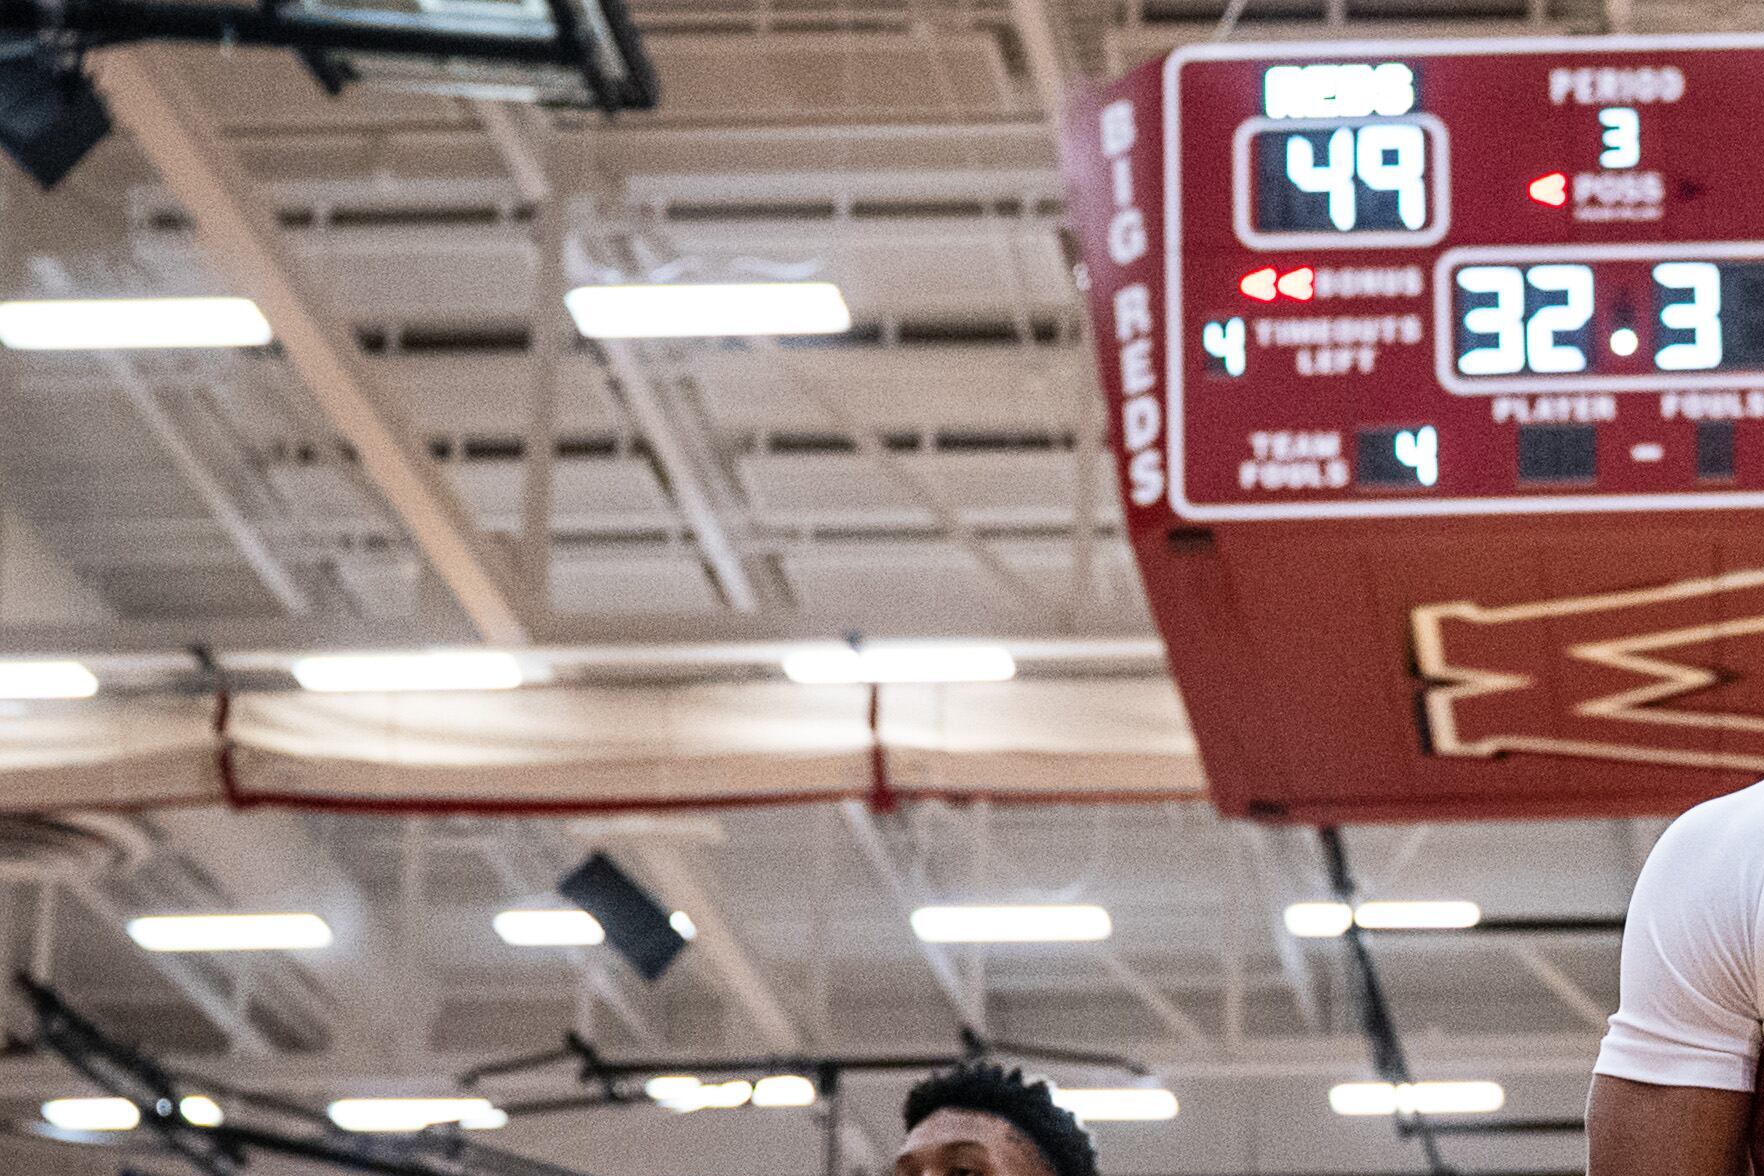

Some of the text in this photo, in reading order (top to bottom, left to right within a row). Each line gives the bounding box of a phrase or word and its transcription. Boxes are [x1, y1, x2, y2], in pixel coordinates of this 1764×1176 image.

[1549, 66, 1686, 104] PERIOD
[1598, 107, 1640, 168] 3
[1285, 125, 1426, 231] 49
[1315, 266, 1423, 298] BONUS
[1103, 100, 1164, 506] BIG REDS
[1456, 262, 1723, 375] 32.3
[1203, 317, 1246, 377] 4
[1254, 313, 1422, 346] TIMEOUTS
[1296, 346, 1376, 376] LEFT
[1491, 395, 1617, 422] PLAYER
[1251, 431, 1342, 459] TEAM
[1394, 425, 1438, 487] 4
[1238, 458, 1349, 488] FOULS
